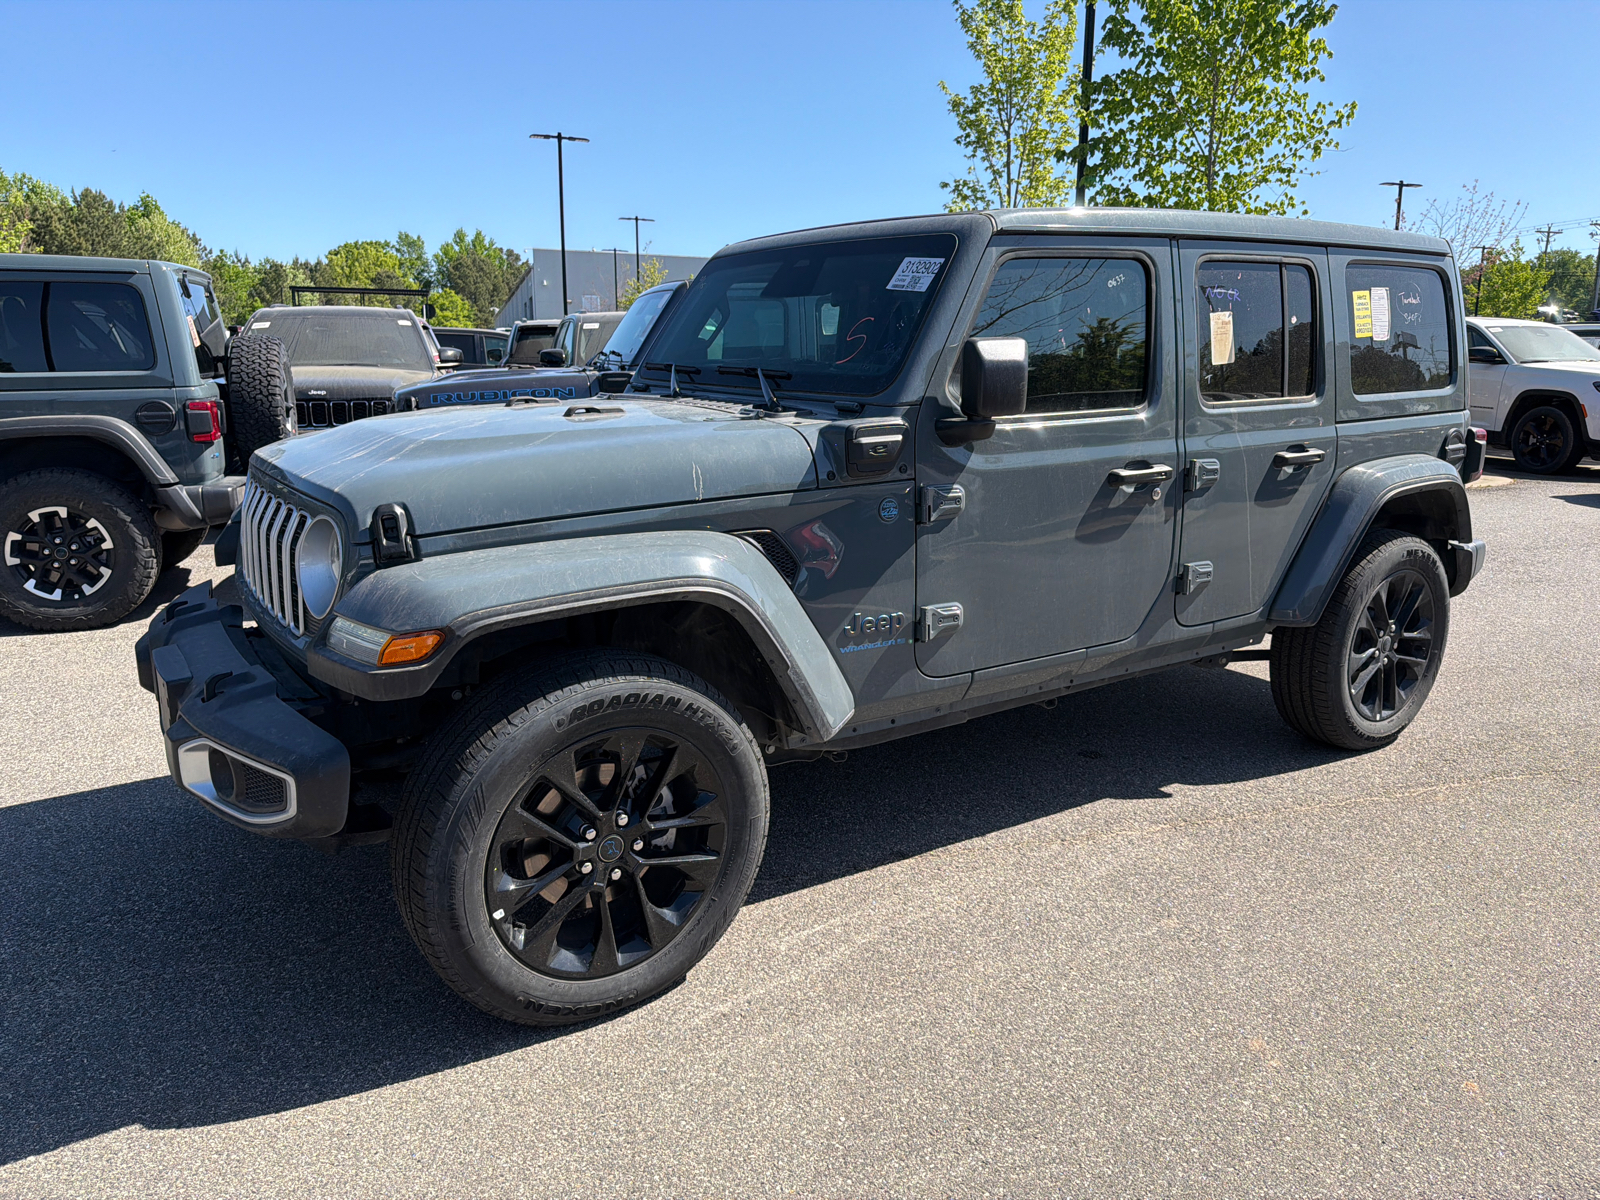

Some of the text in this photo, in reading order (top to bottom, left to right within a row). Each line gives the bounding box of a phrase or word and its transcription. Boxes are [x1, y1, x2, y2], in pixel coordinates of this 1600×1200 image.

[902, 260, 943, 275] 3132902
[431, 387, 576, 404] RUBICON
[1405, 549, 1438, 568] NEXEN
[844, 612, 905, 637] Jeep
[840, 640, 895, 654] WRANGLER
[567, 692, 683, 725] ROADIAN
[523, 997, 624, 1016] NEXEN
